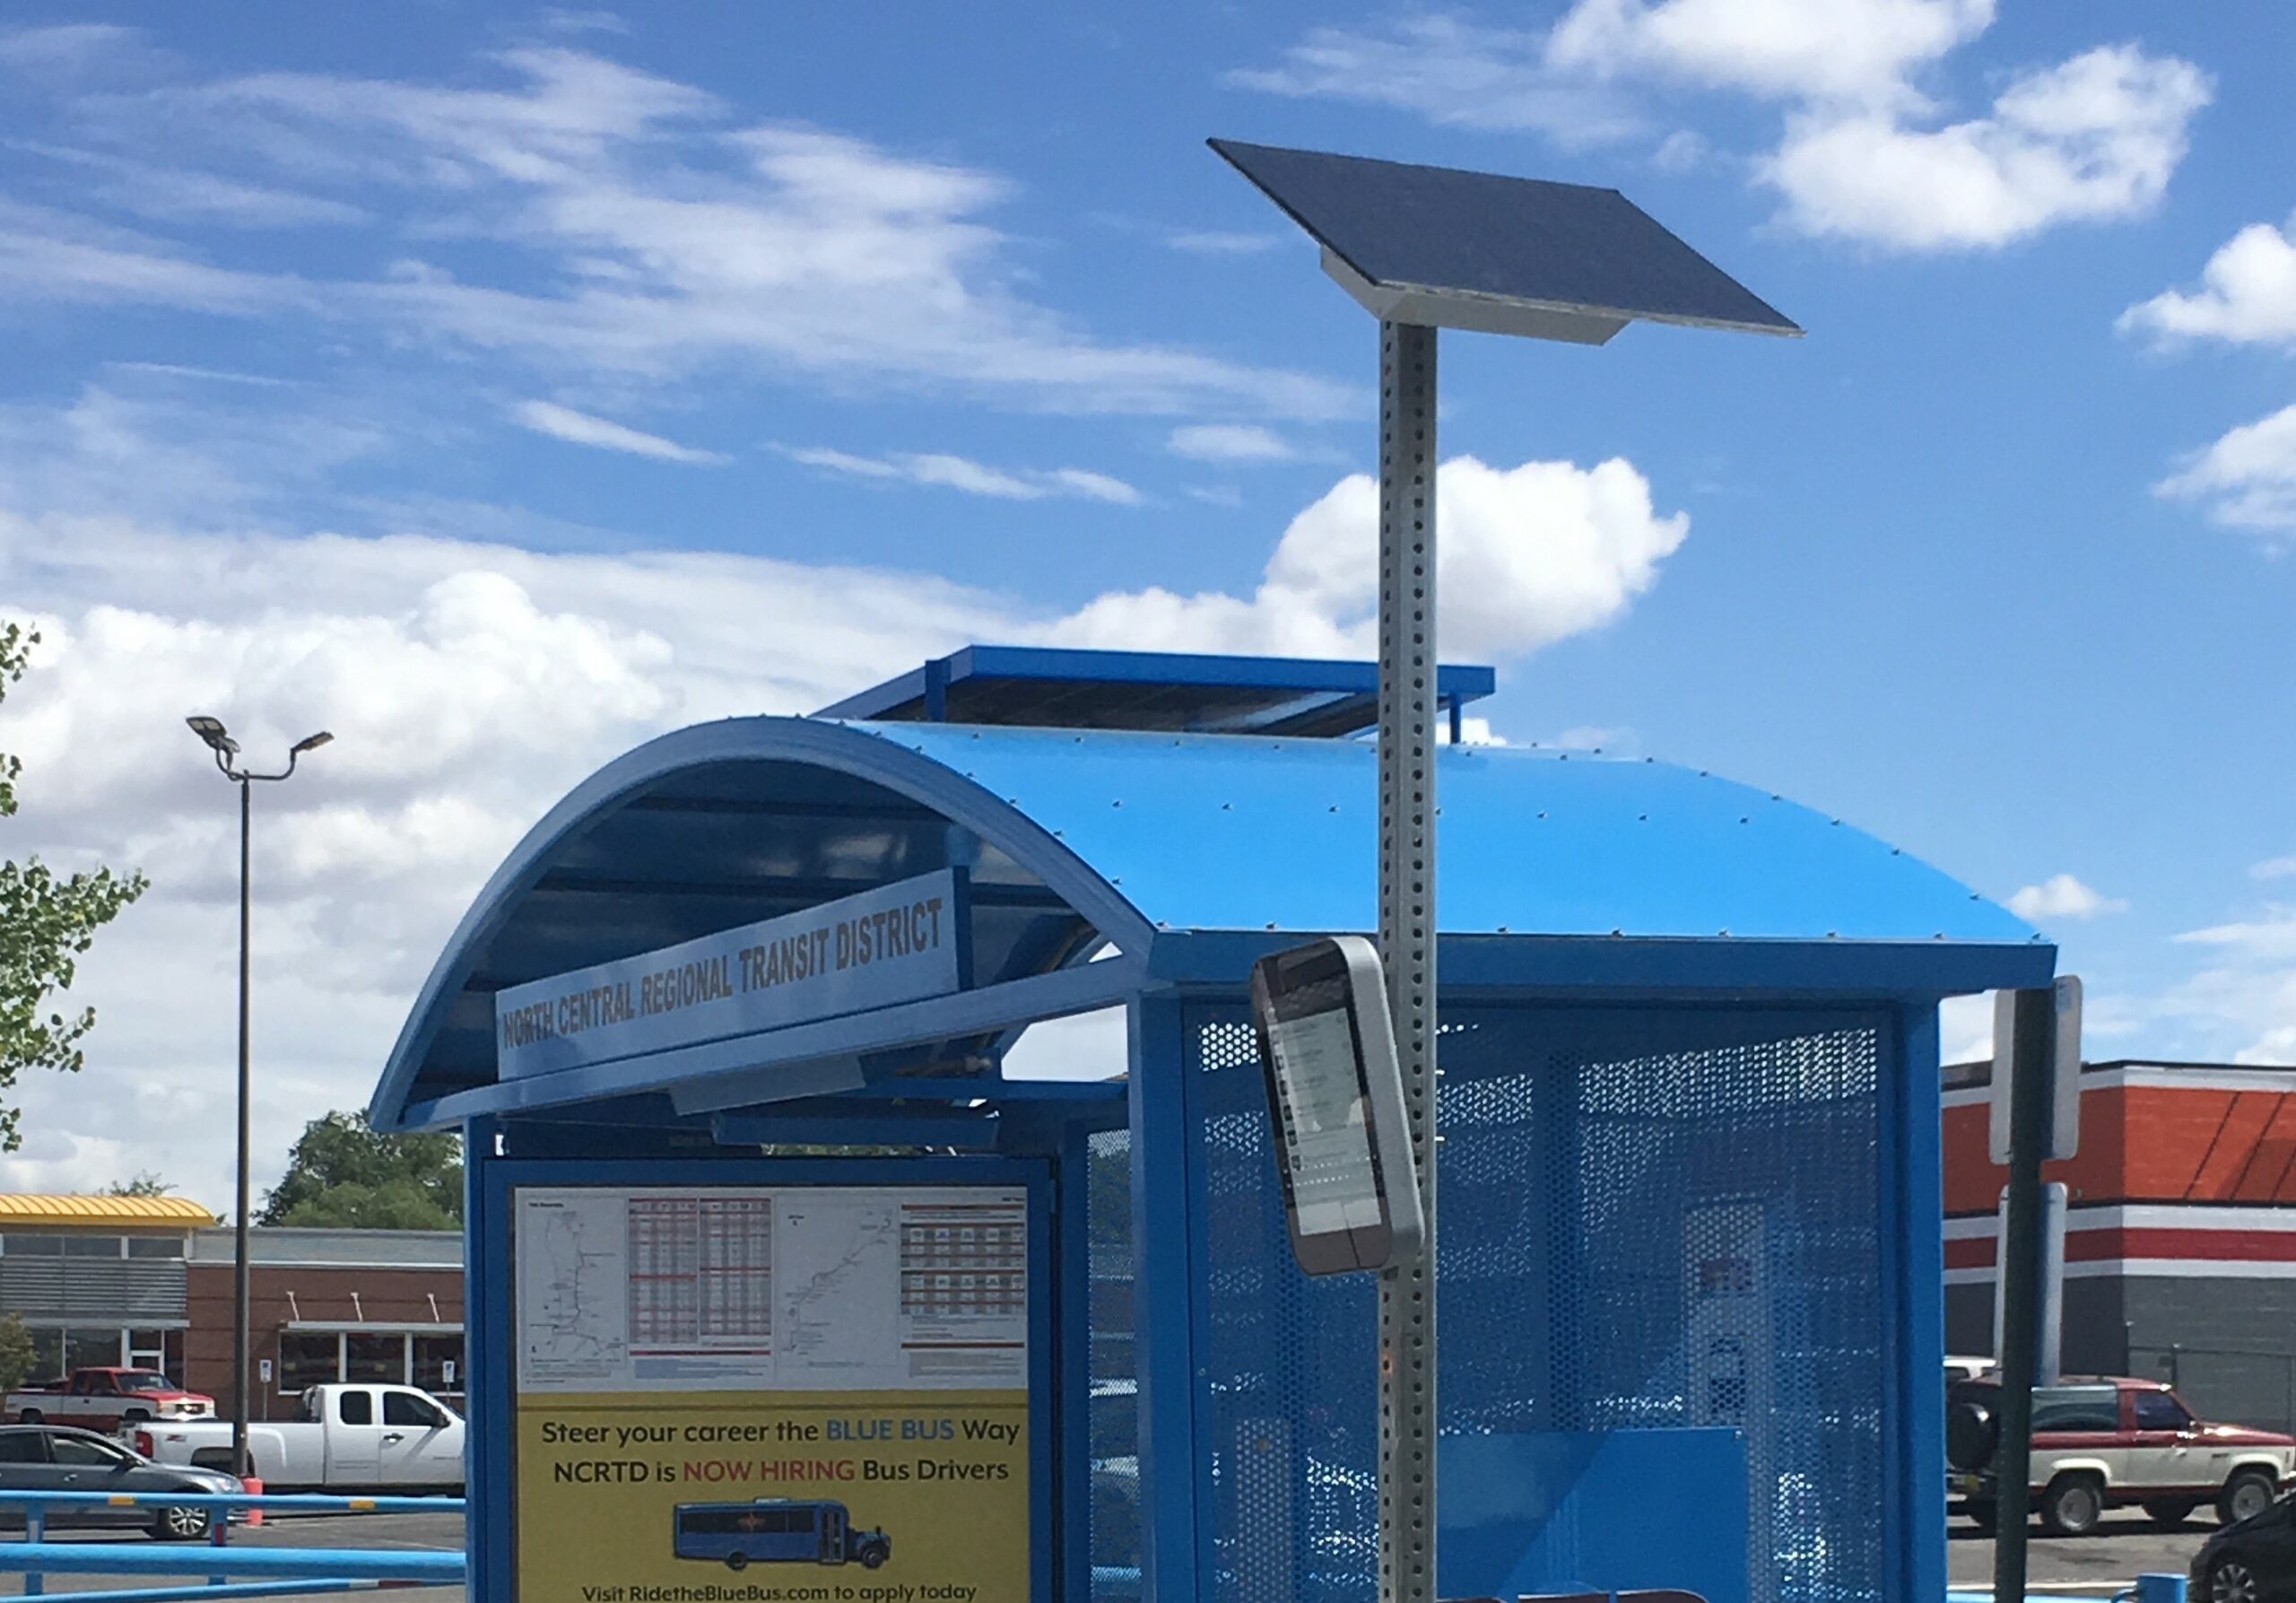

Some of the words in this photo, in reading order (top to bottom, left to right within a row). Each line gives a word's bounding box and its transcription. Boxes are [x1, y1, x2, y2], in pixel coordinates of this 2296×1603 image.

[503, 999, 554, 1050] NORTH
[558, 982, 635, 1035] CENTRAL
[640, 955, 734, 1015] REGIONAL
[739, 928, 830, 994] TRANSIT
[836, 898, 943, 970] DISTRICT
[541, 1421, 611, 1443] Steer
[616, 1424, 677, 1448] your
[683, 1424, 770, 1442] career
[776, 1421, 819, 1442] the
[826, 1419, 894, 1441] BLUE
[900, 1418, 955, 1441] BUS
[961, 1418, 1021, 1445] Way
[553, 1461, 649, 1483] NCRTD
[656, 1460, 676, 1483] is
[683, 1460, 753, 1482] NOW
[761, 1459, 856, 1482] HIRING
[863, 1459, 911, 1481] Bus
[918, 1459, 1010, 1480] Drivers
[581, 1586, 625, 1602] Visit
[630, 1584, 829, 1602] RidetheBlueBus.com
[834, 1585, 855, 1600] to
[859, 1584, 915, 1603] apply
[919, 1583, 978, 1603] today
